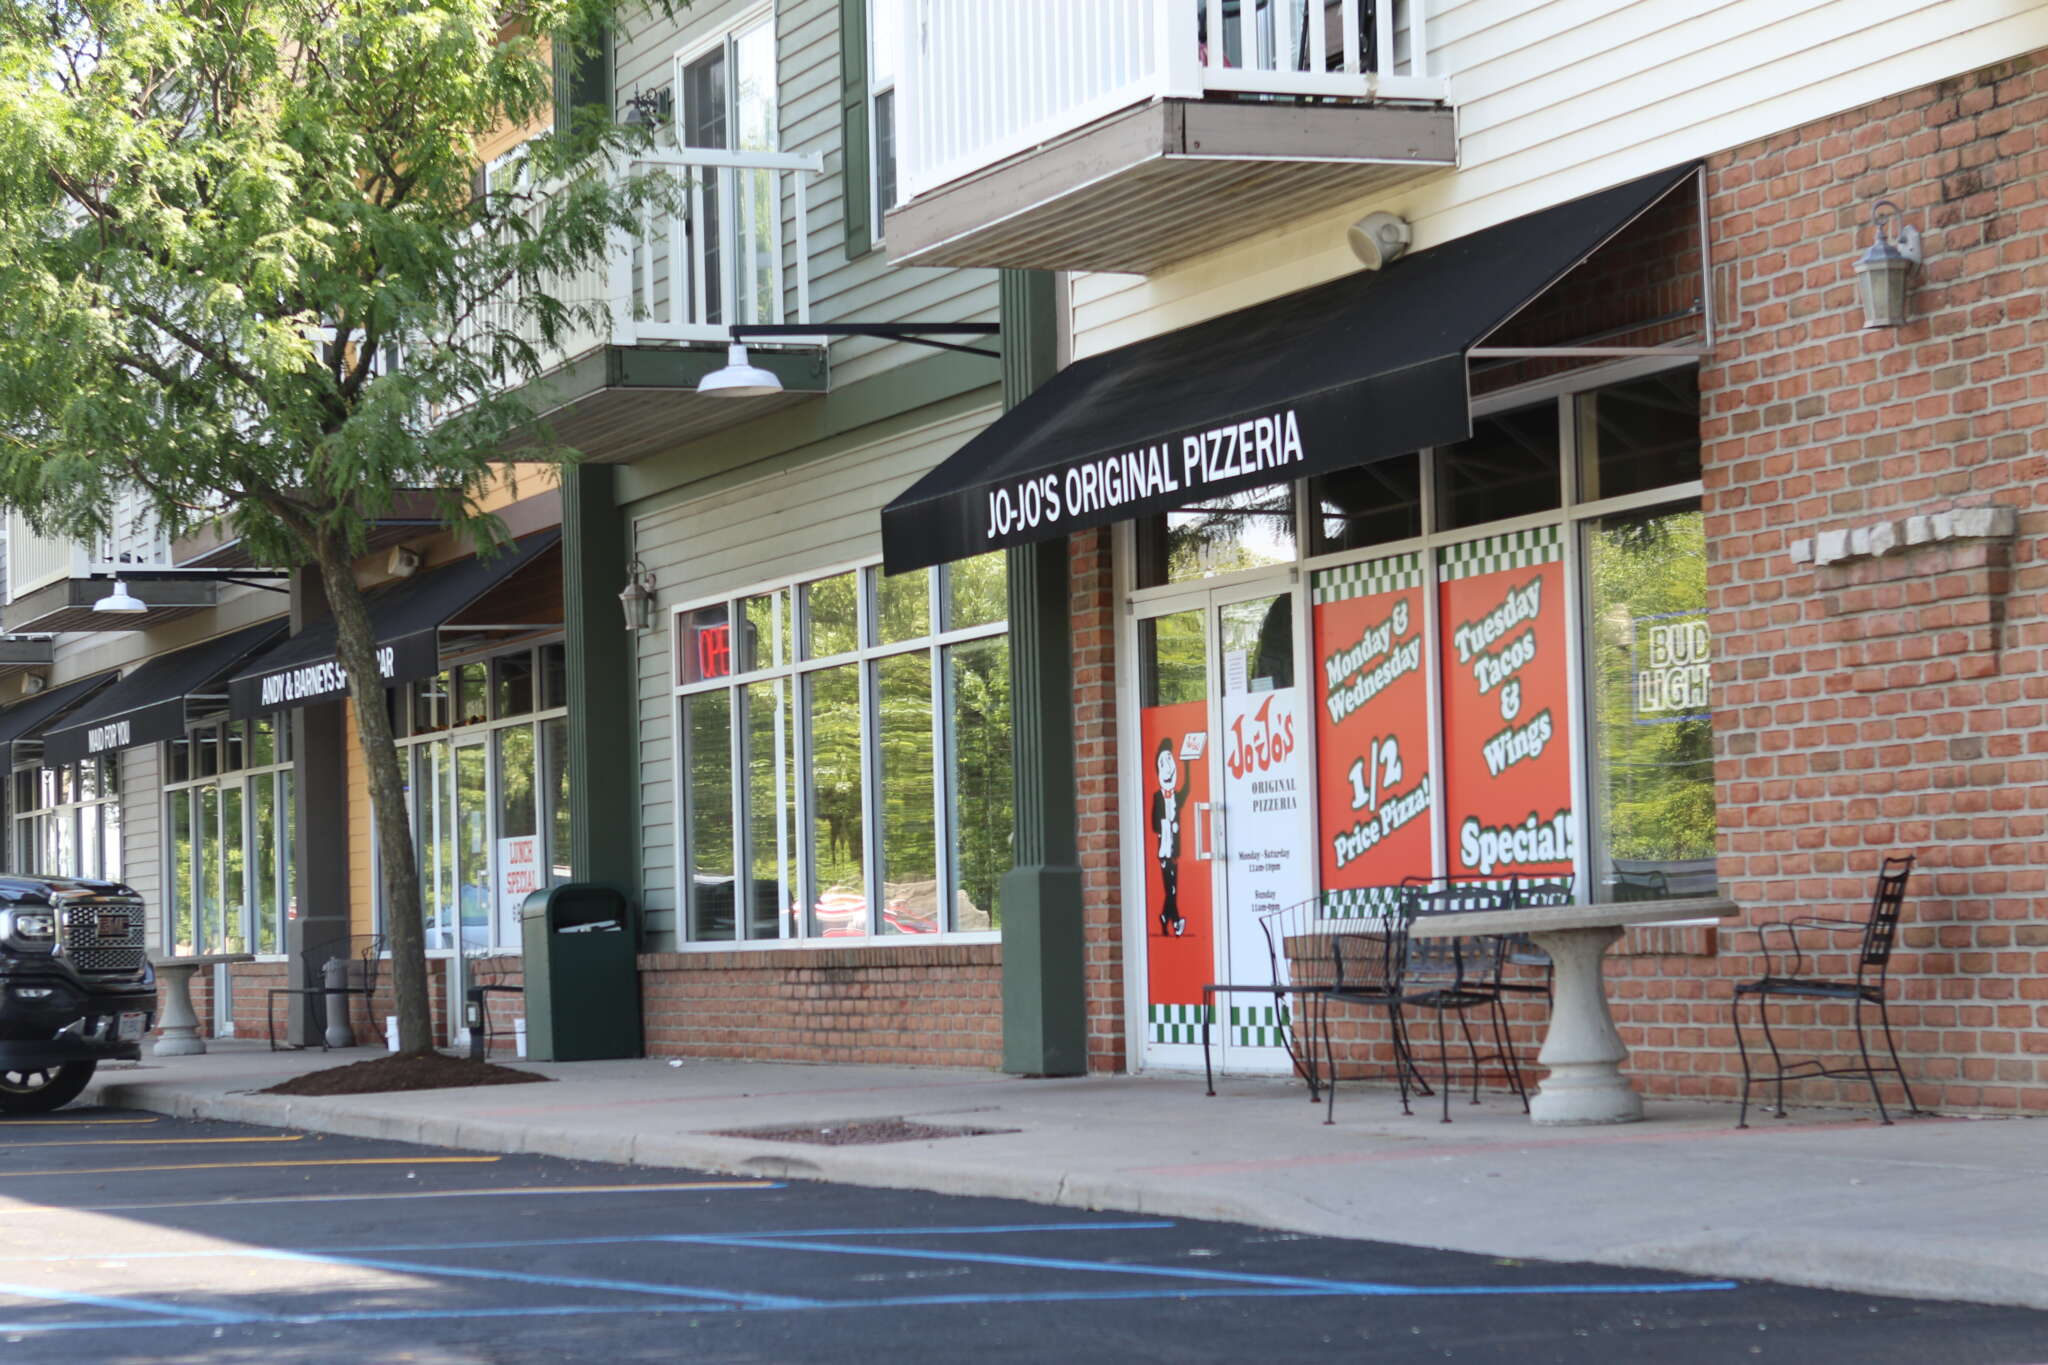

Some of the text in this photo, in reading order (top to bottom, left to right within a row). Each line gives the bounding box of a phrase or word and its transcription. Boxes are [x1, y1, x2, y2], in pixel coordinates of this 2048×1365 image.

[987, 409, 1304, 539] JO-JO'S ORIGINAL PIZZERIA
[1325, 599, 1408, 690] Monday &
[1454, 575, 1541, 664] Tuesday
[1650, 620, 1711, 668] BUD
[261, 673, 285, 706] ANDY
[285, 671, 294, 701] &
[376, 646, 395, 679] AR
[1326, 634, 1420, 724] Wednesday
[1472, 628, 1535, 694] Tacos
[1501, 678, 1521, 721] &
[1639, 664, 1712, 713] LIGH
[88, 720, 130, 753] MAID FOR YOU
[1482, 709, 1553, 779] Wings
[1251, 778, 1297, 795] ORIGINAL
[1348, 736, 1403, 812] 1/2
[1252, 797, 1297, 813] PIZZERIA
[1333, 773, 1430, 868] Price Pizza!
[509, 840, 533, 865] LUNCH
[1238, 850, 1260, 861] Monday
[1264, 848, 1290, 860] Saturday
[1460, 811, 1574, 876] Special!
[507, 870, 537, 894] SPECIAL
[1254, 890, 1276, 901] Sunday
